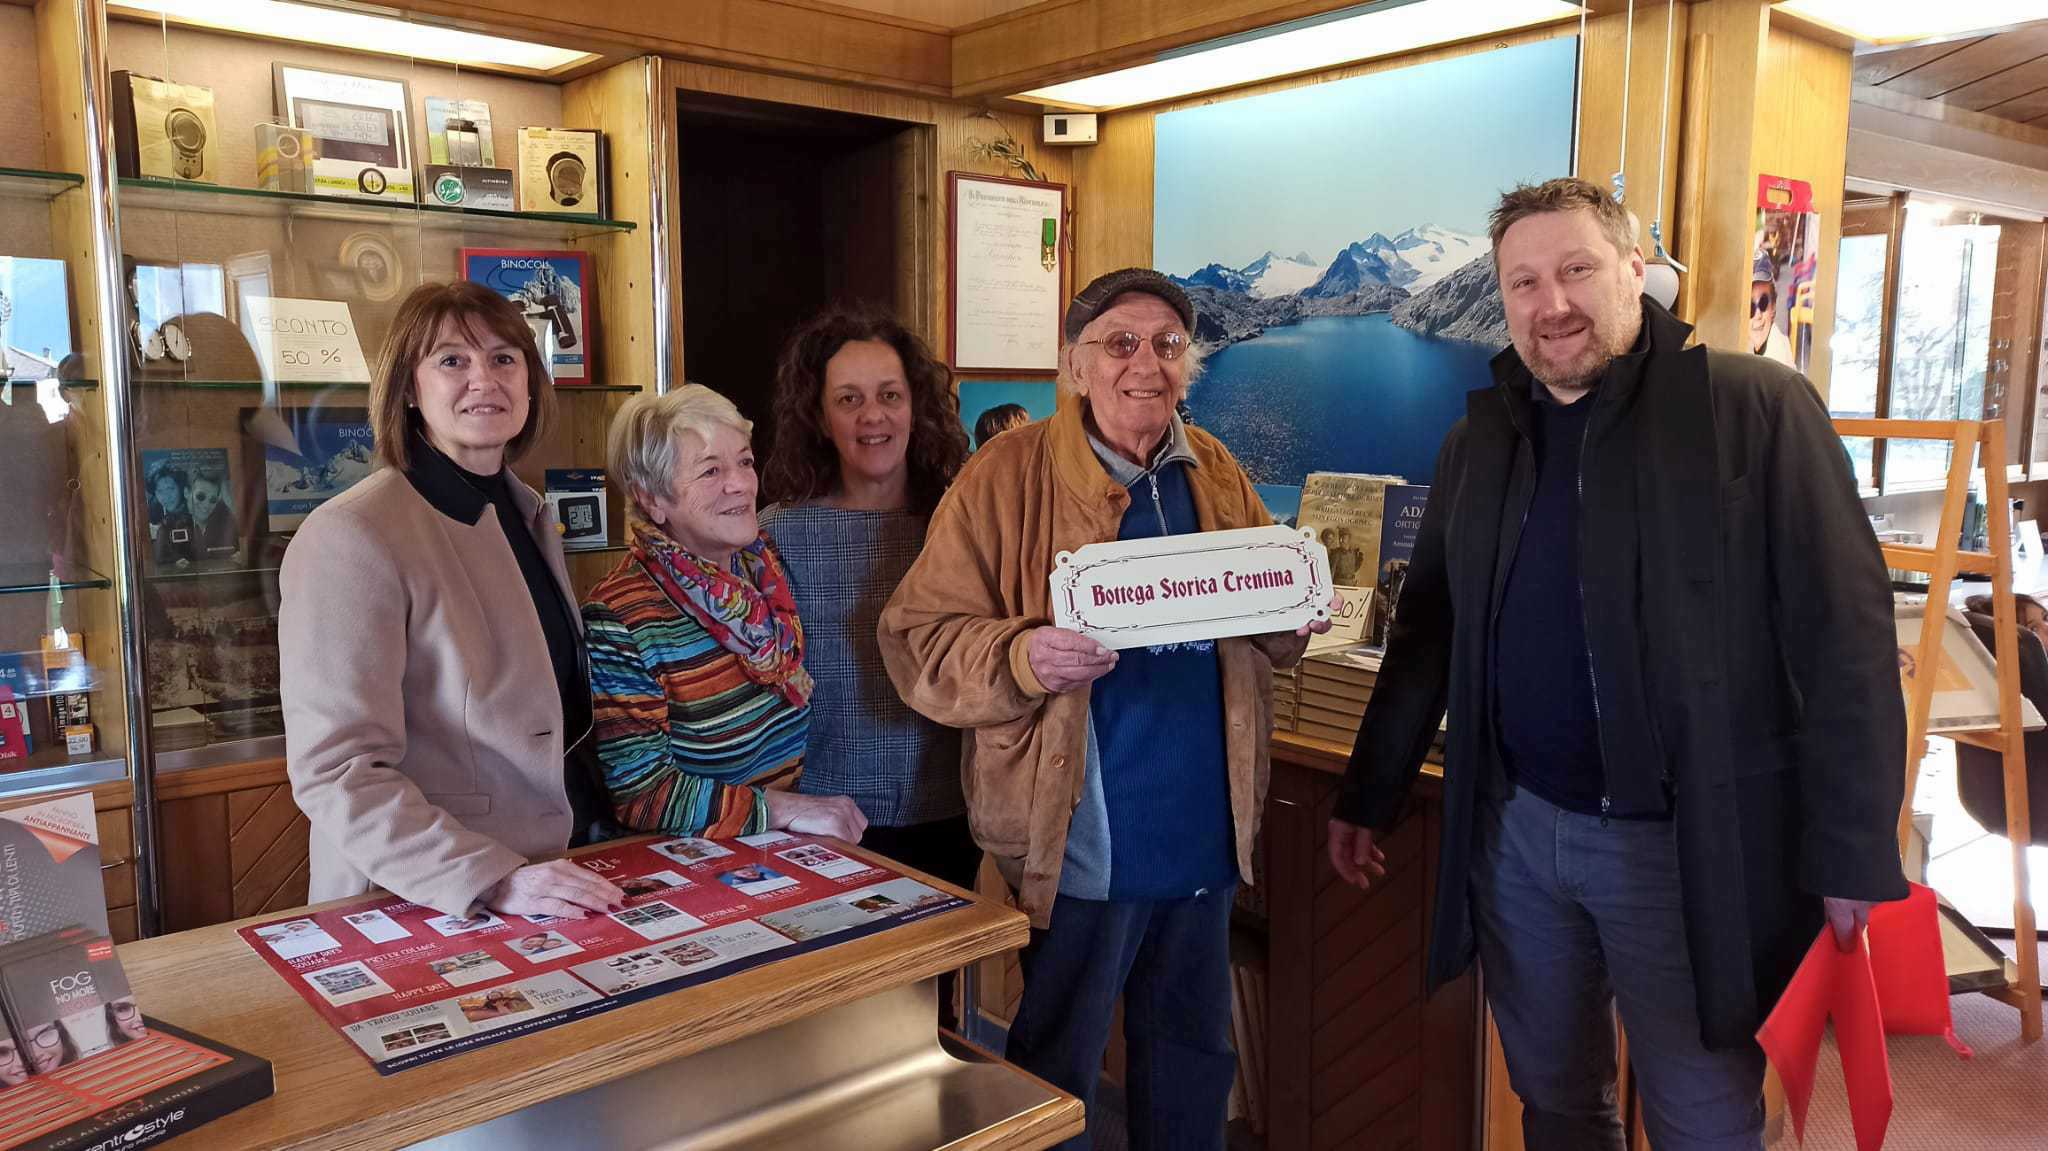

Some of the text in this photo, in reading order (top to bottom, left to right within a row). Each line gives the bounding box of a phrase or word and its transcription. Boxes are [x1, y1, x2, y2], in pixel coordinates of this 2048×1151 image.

[259, 316, 349, 336] SCONTO
[281, 348, 342, 365] 50 %
[1091, 567, 1295, 607] Bottega Storica Trentina
[49, 970, 92, 994] FOG
[55, 992, 72, 1005] NO
[386, 1056, 418, 1069] SCOPRI
[420, 1049, 444, 1059] TUTTE
